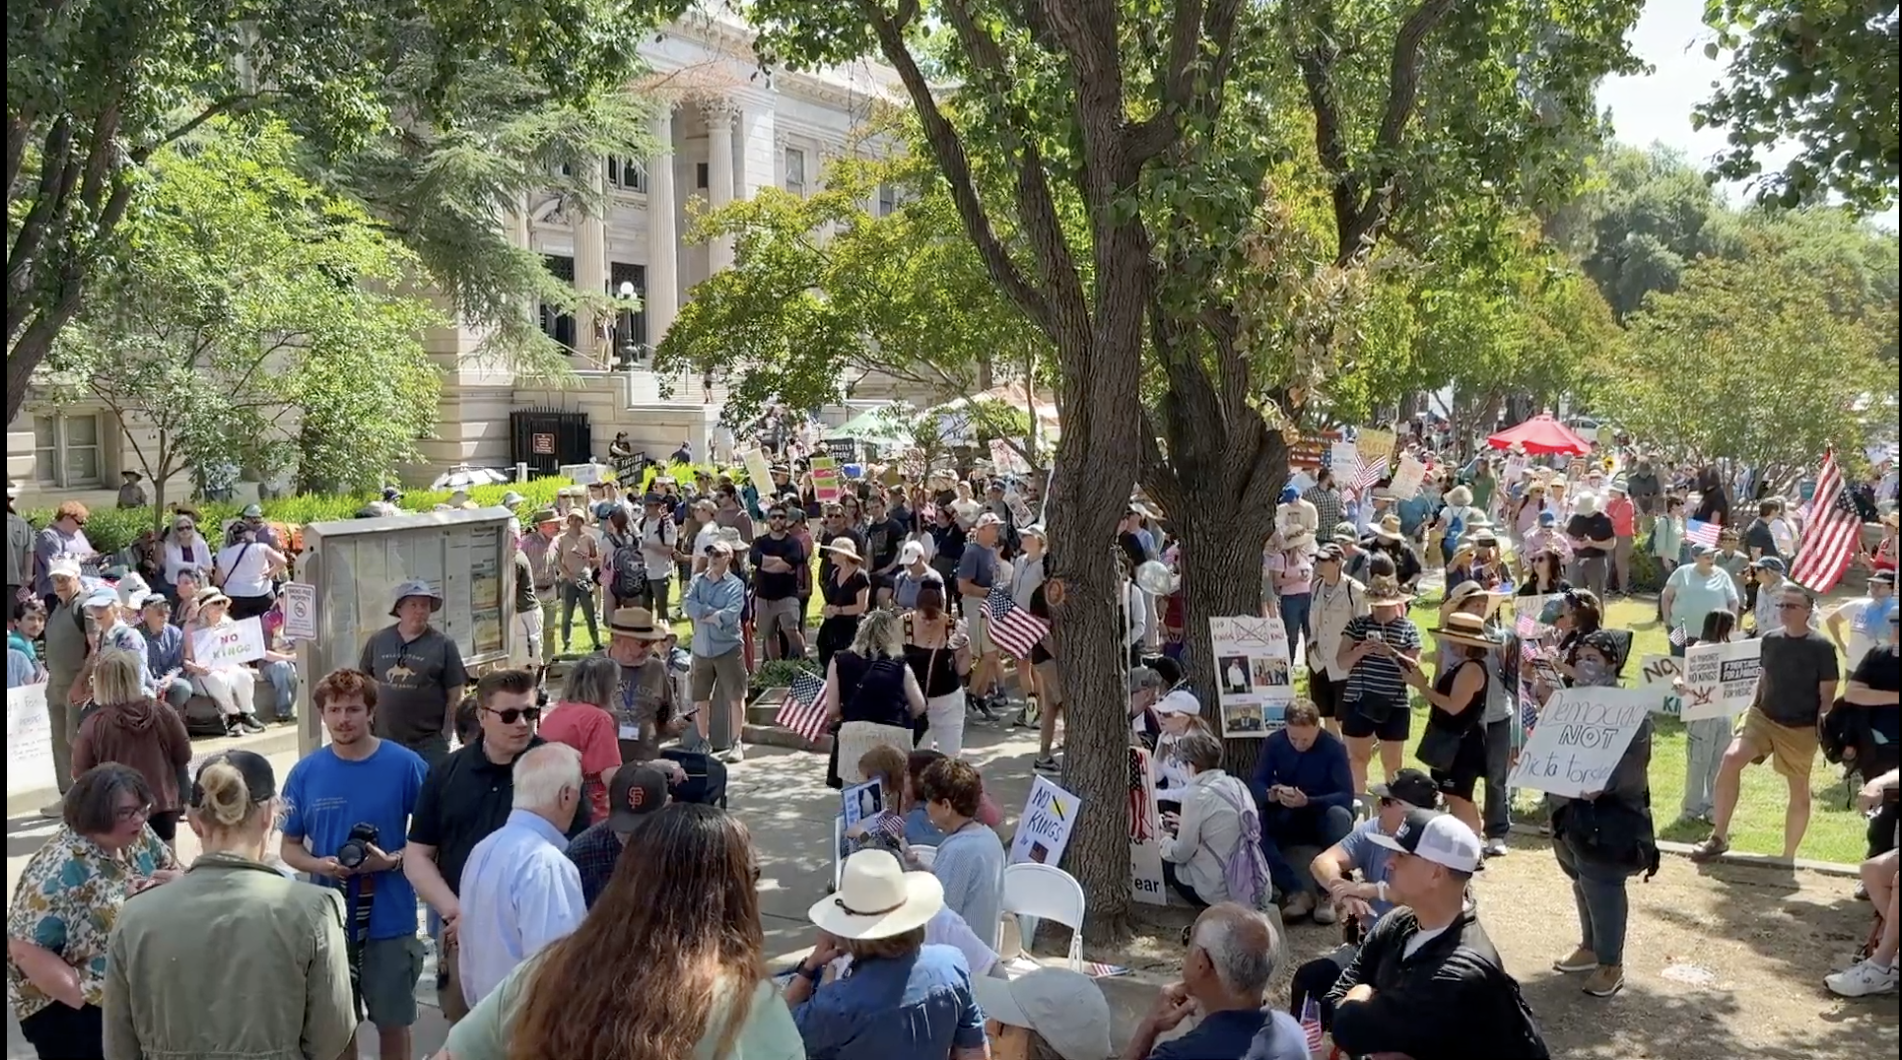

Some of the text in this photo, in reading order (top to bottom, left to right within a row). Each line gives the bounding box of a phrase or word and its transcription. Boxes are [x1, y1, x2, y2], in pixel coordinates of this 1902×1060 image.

[220, 633, 239, 645] NO
[1558, 724, 1619, 750] NOT
[629, 786, 645, 809] SF
[1032, 786, 1051, 809] NO
[1134, 878, 1160, 894] ear
